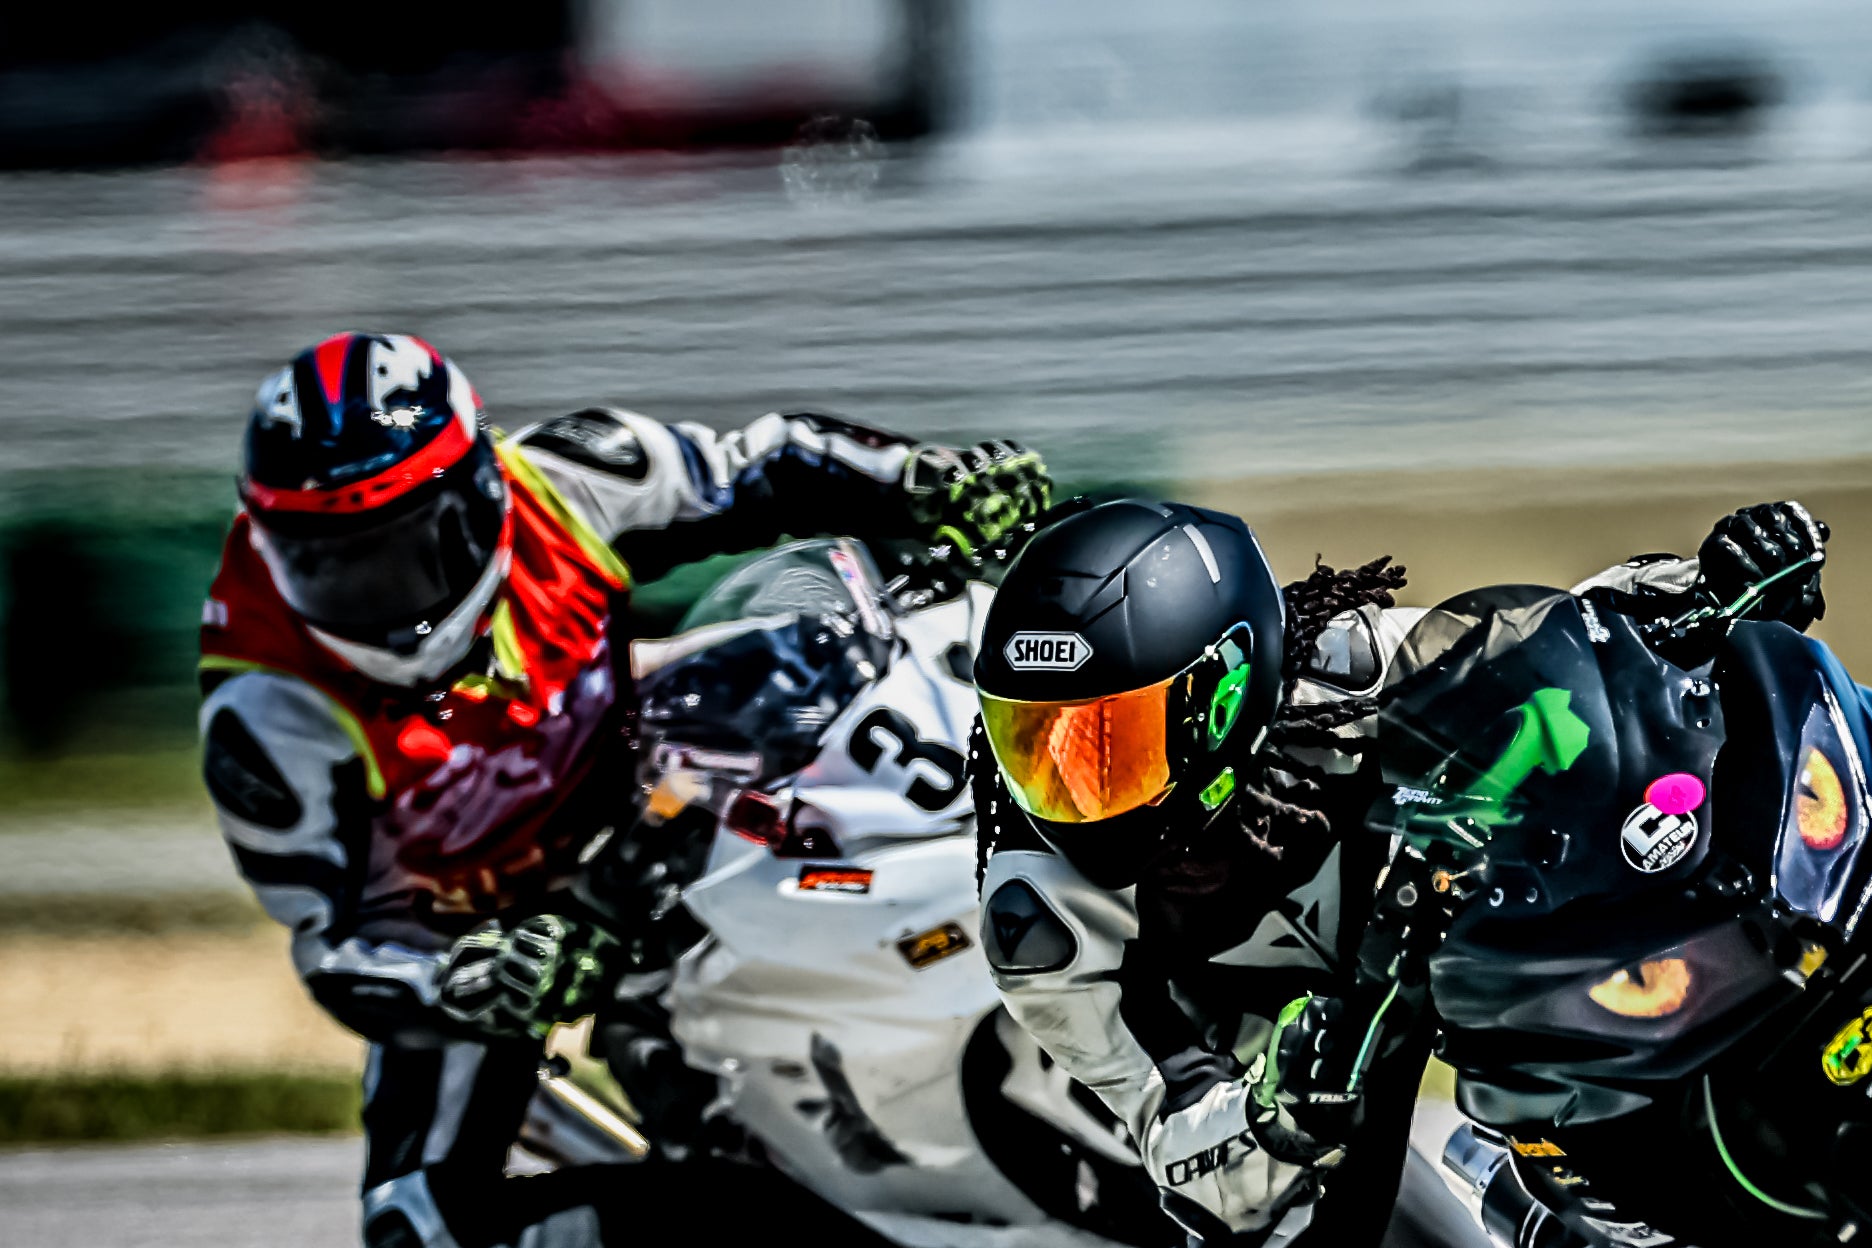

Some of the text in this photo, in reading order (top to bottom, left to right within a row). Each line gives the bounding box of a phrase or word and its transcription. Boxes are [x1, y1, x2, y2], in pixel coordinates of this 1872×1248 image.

[1013, 639, 1076, 663] SHOEI
[849, 708, 966, 812] 3
[1642, 821, 1697, 871] AMATEUR
